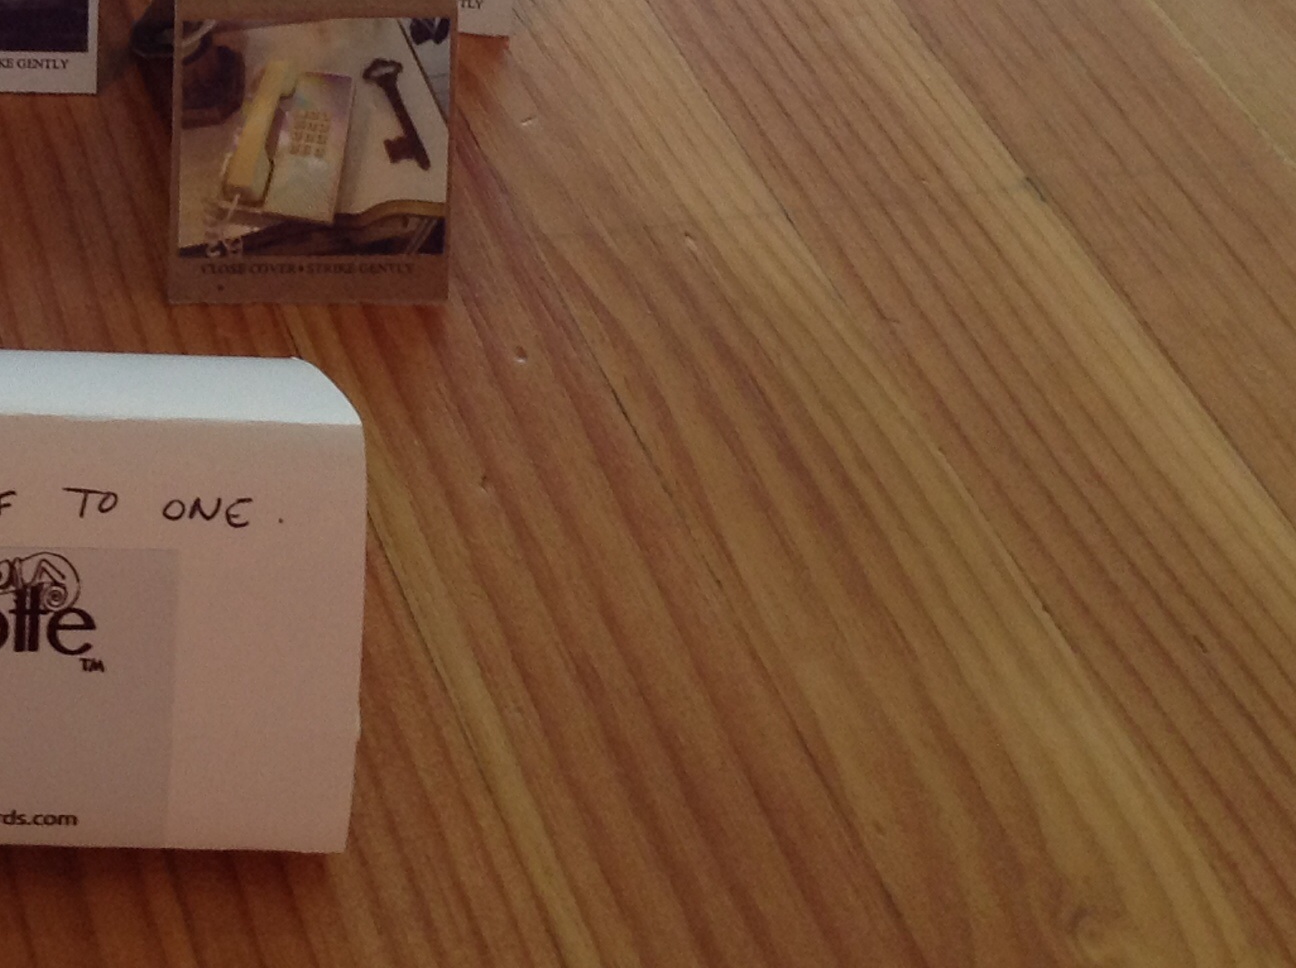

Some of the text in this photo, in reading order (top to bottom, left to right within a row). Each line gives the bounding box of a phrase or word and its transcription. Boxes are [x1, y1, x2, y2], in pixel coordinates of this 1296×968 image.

[16, 58, 69, 70] GENTLY
[201, 262, 415, 275] CLOSE COVER STRIKE GENTLY
[63, 486, 119, 518] TO
